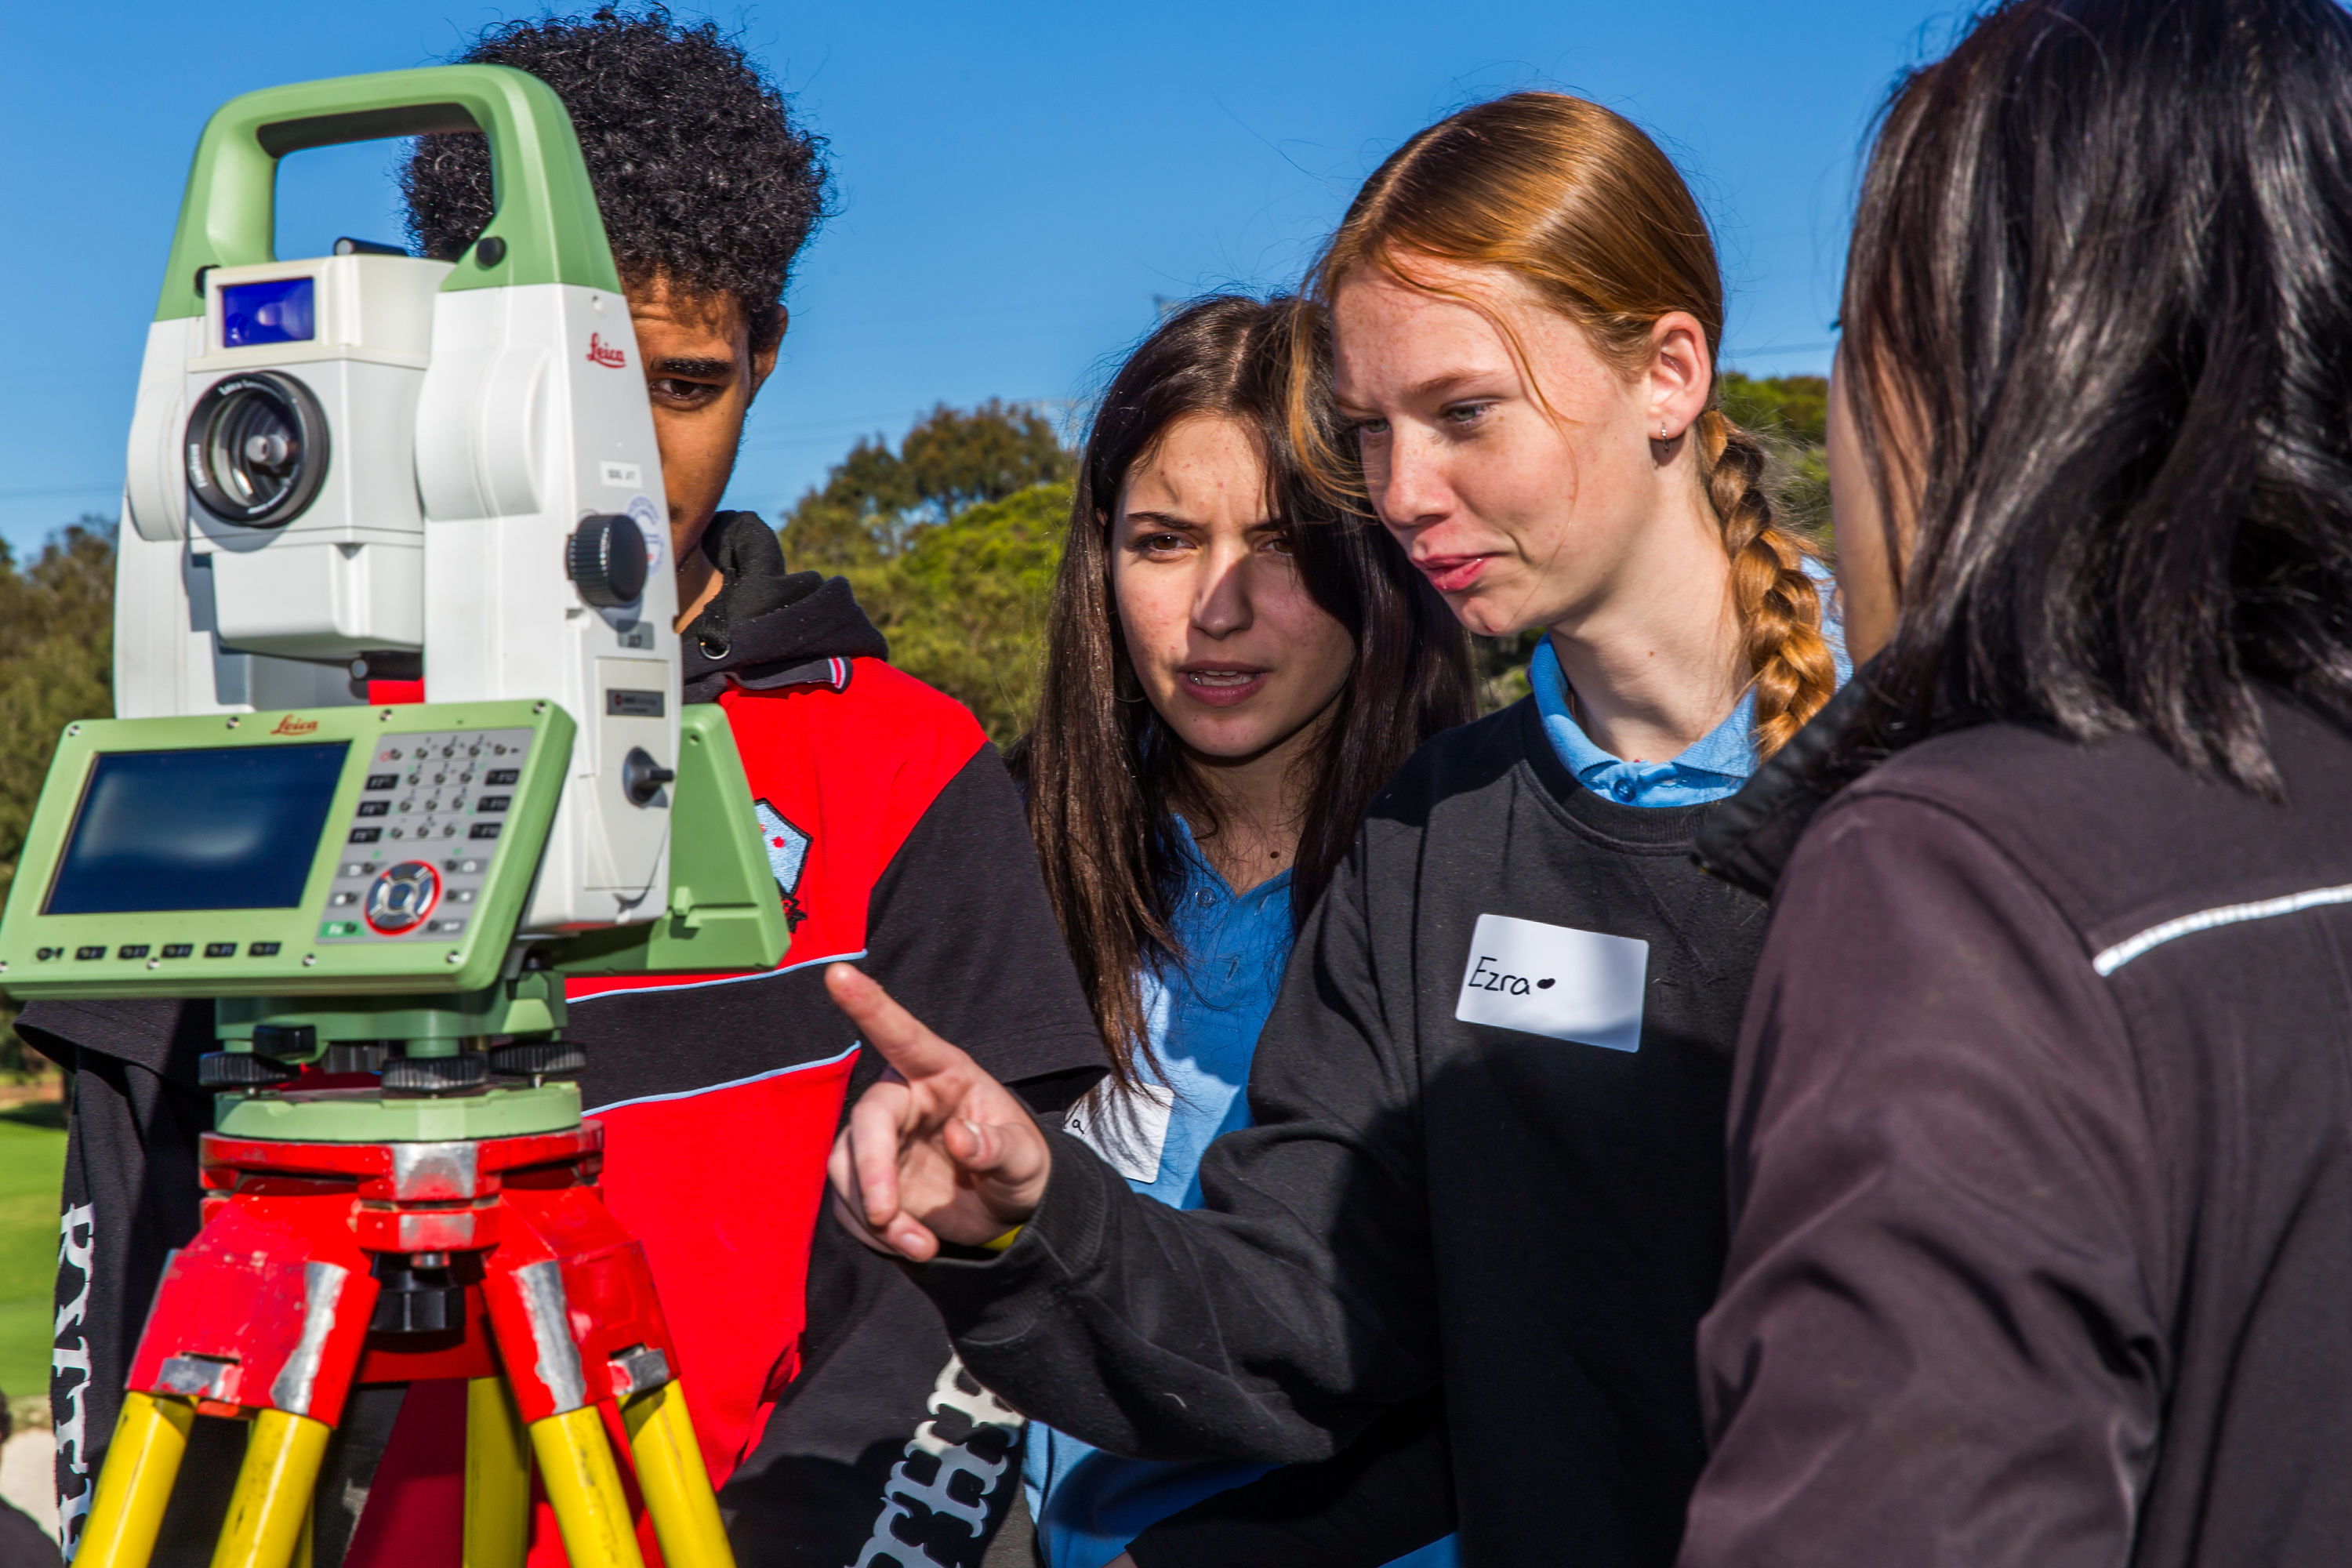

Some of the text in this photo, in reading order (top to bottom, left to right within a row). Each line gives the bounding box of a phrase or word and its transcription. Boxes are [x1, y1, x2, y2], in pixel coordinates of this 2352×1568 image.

[586, 332, 626, 368] Leica
[270, 713, 318, 736] Leica
[1468, 956, 1530, 996] Ezra
